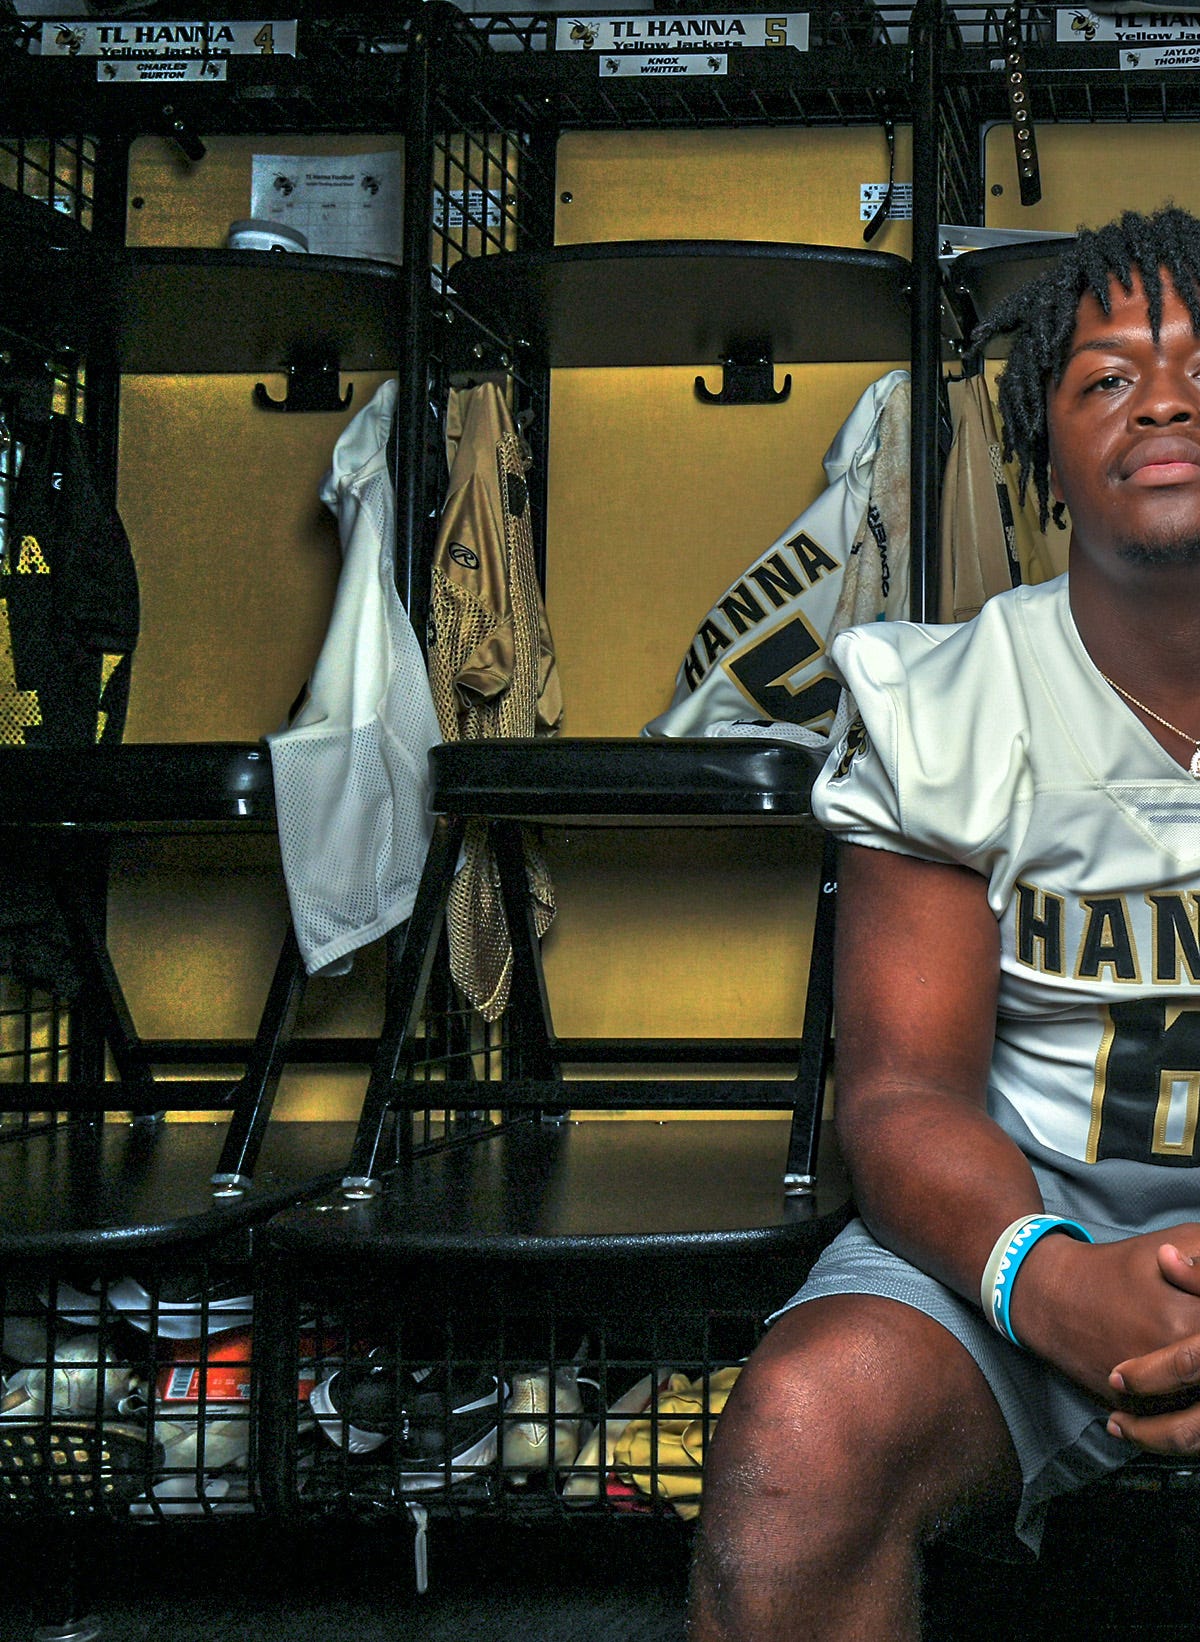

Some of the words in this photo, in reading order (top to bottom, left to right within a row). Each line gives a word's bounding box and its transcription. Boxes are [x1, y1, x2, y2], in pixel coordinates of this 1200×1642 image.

[1114, 12, 1143, 28] TL
[609, 20, 642, 37] TL
[647, 19, 747, 37] HANNA
[764, 17, 788, 47] 5
[1114, 32, 1173, 42] Yellow
[97, 26, 129, 44] TL
[135, 26, 235, 44] HANNA
[253, 23, 275, 54] 4
[612, 40, 672, 50] Yellow
[673, 39, 744, 50] Jackets
[100, 46, 160, 56] Yellow
[647, 57, 679, 65] KNOX
[136, 63, 188, 71] CHARLES
[640, 65, 688, 73] WHITTEN
[139, 71, 186, 80] BURTON
[683, 529, 842, 694] HANNA
